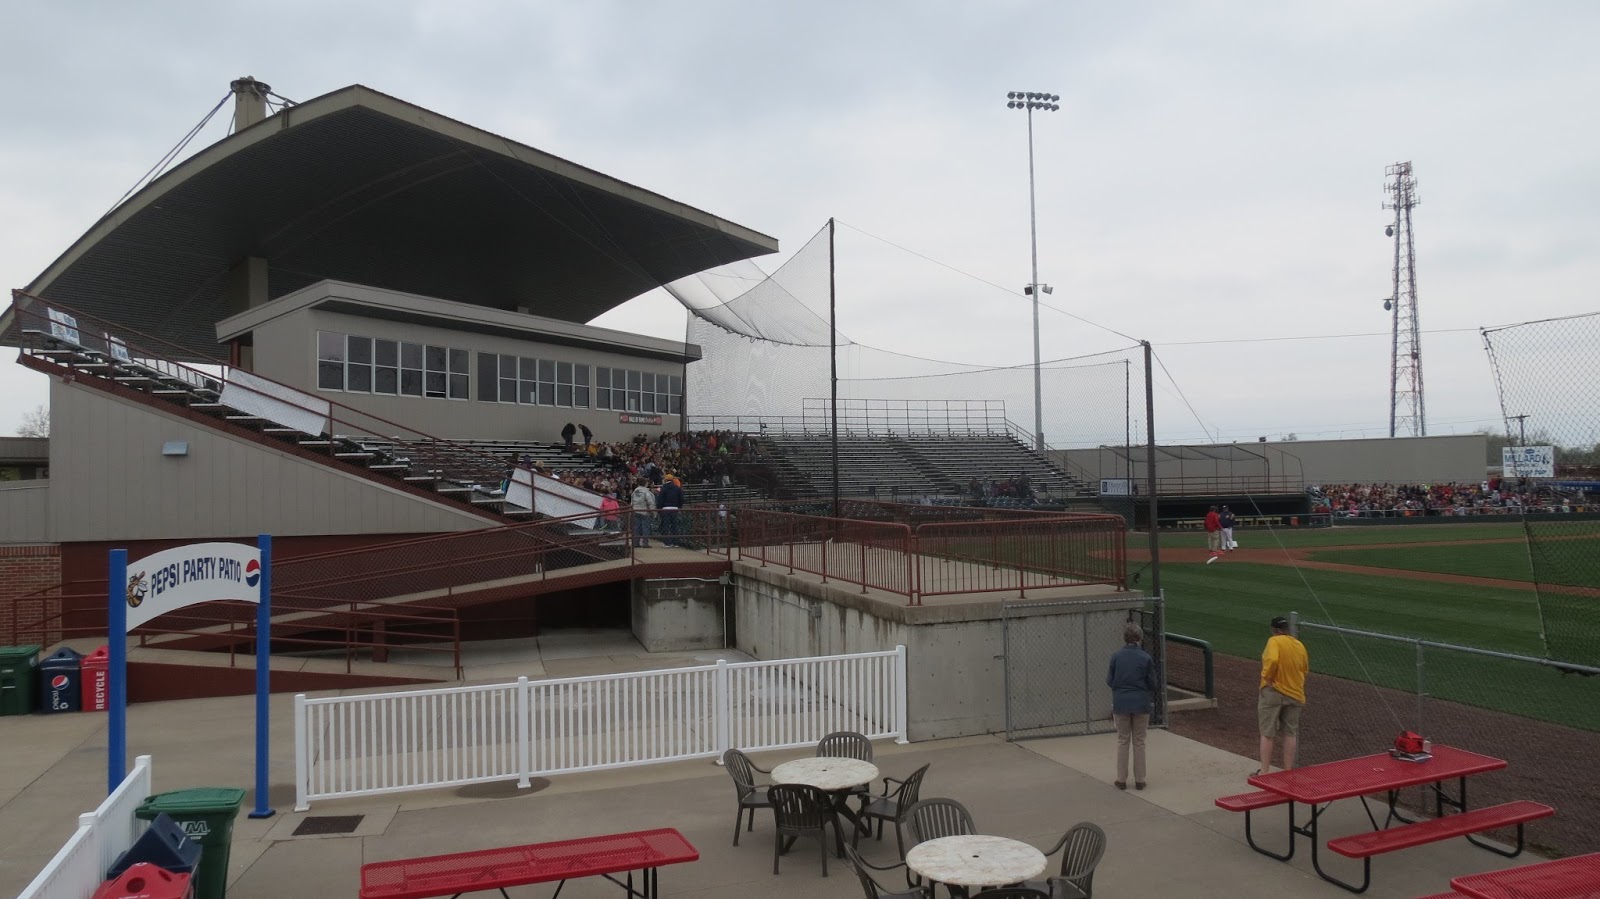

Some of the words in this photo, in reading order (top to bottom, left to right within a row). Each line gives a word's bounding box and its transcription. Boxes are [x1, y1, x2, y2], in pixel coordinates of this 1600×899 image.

[1504, 454, 1541, 462] MILLARD
[151, 563, 180, 598] PEPSI
[183, 557, 216, 583] PARTY
[219, 557, 242, 583] PATIO
[95, 671, 105, 710] RECYCLE
